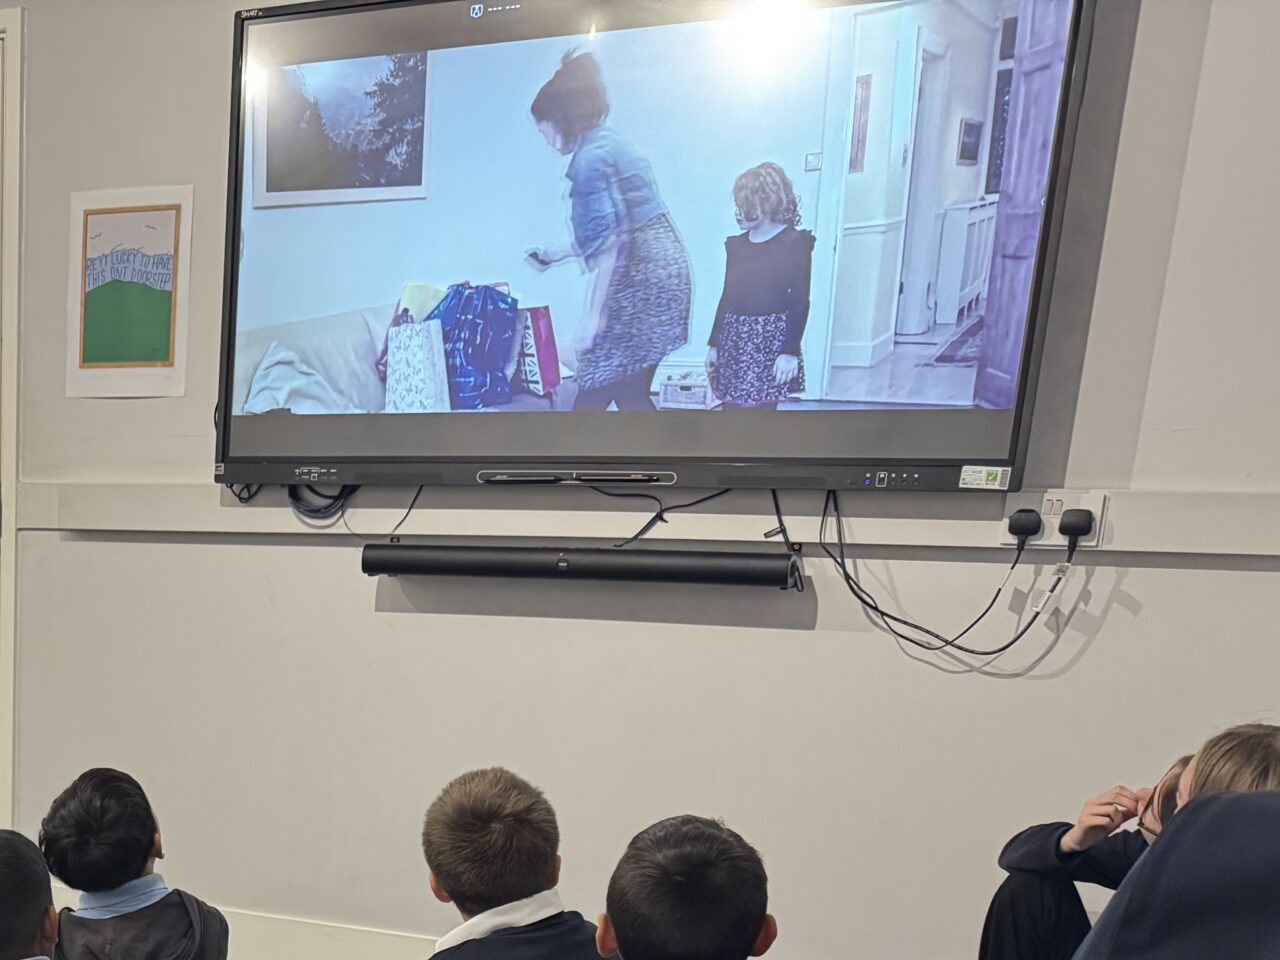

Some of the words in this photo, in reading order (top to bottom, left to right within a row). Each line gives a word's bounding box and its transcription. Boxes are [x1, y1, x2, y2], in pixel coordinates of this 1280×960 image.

[111, 252, 139, 265] LUCKY
[141, 256, 150, 269] TO
[152, 256, 172, 271] HAVE
[87, 269, 106, 288] THIS
[131, 268, 172, 288] DOORSTEP
